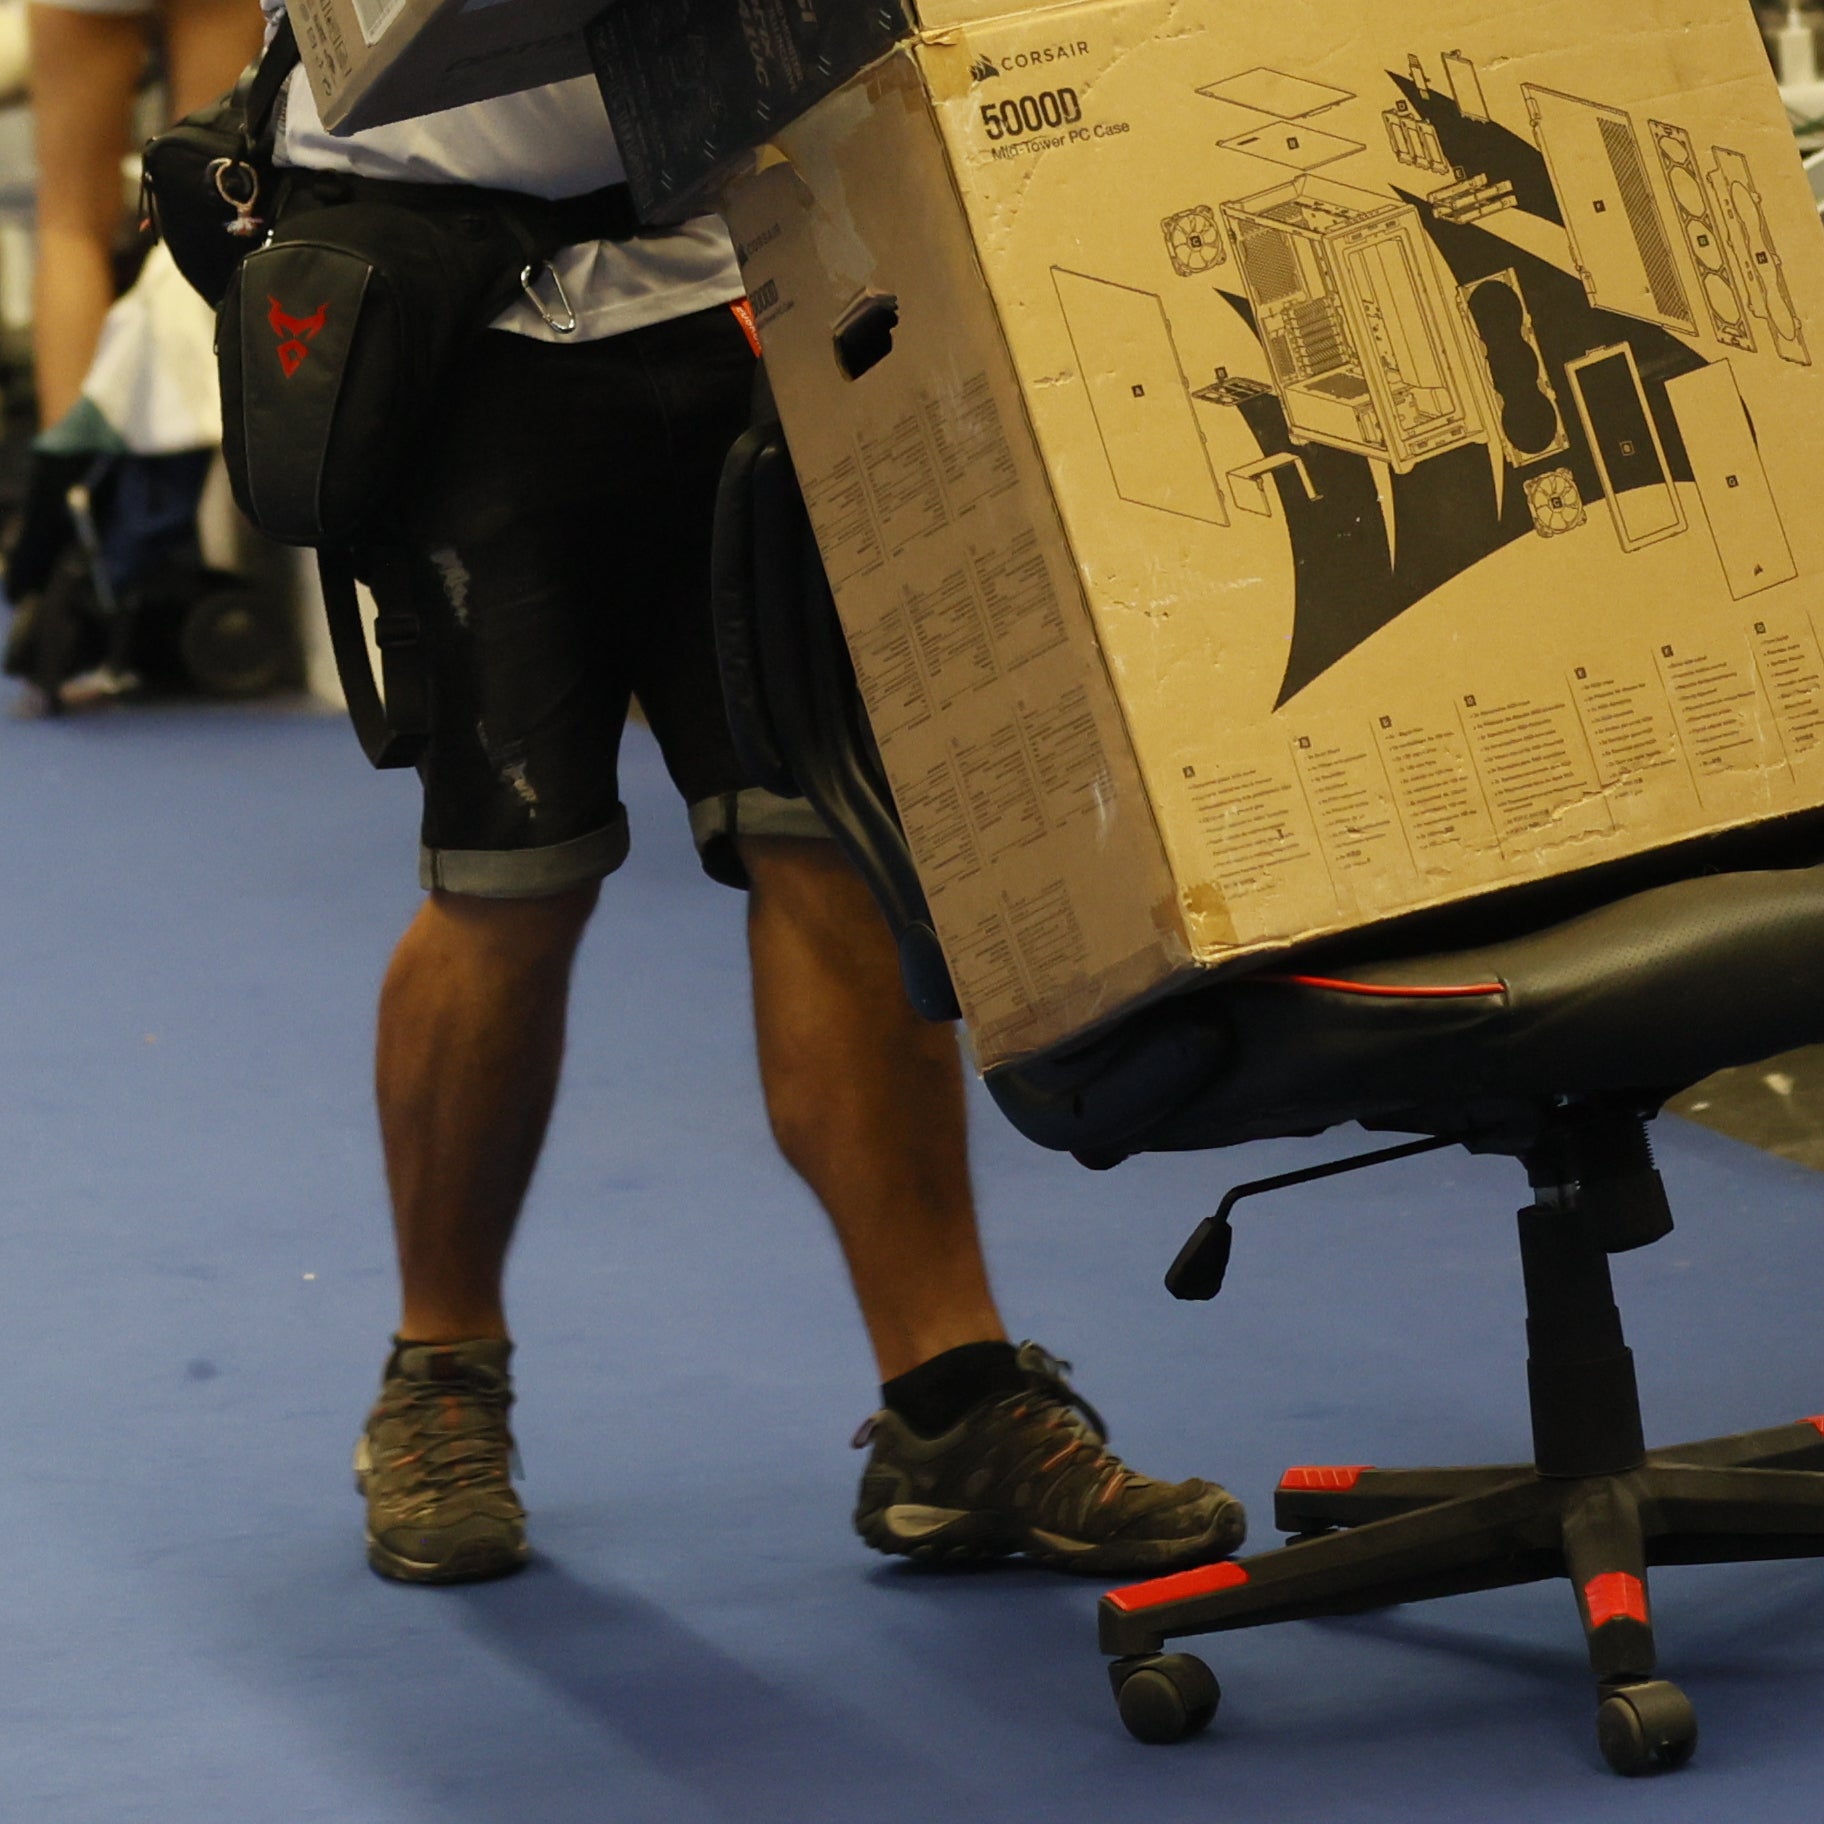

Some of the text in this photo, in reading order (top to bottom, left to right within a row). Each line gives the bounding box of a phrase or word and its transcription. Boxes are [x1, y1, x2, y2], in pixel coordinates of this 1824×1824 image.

[1001, 40, 1090, 71] CORSAIR
[980, 86, 1082, 141] 5000D
[991, 121, 1130, 161] Mid-Tower PC Case
